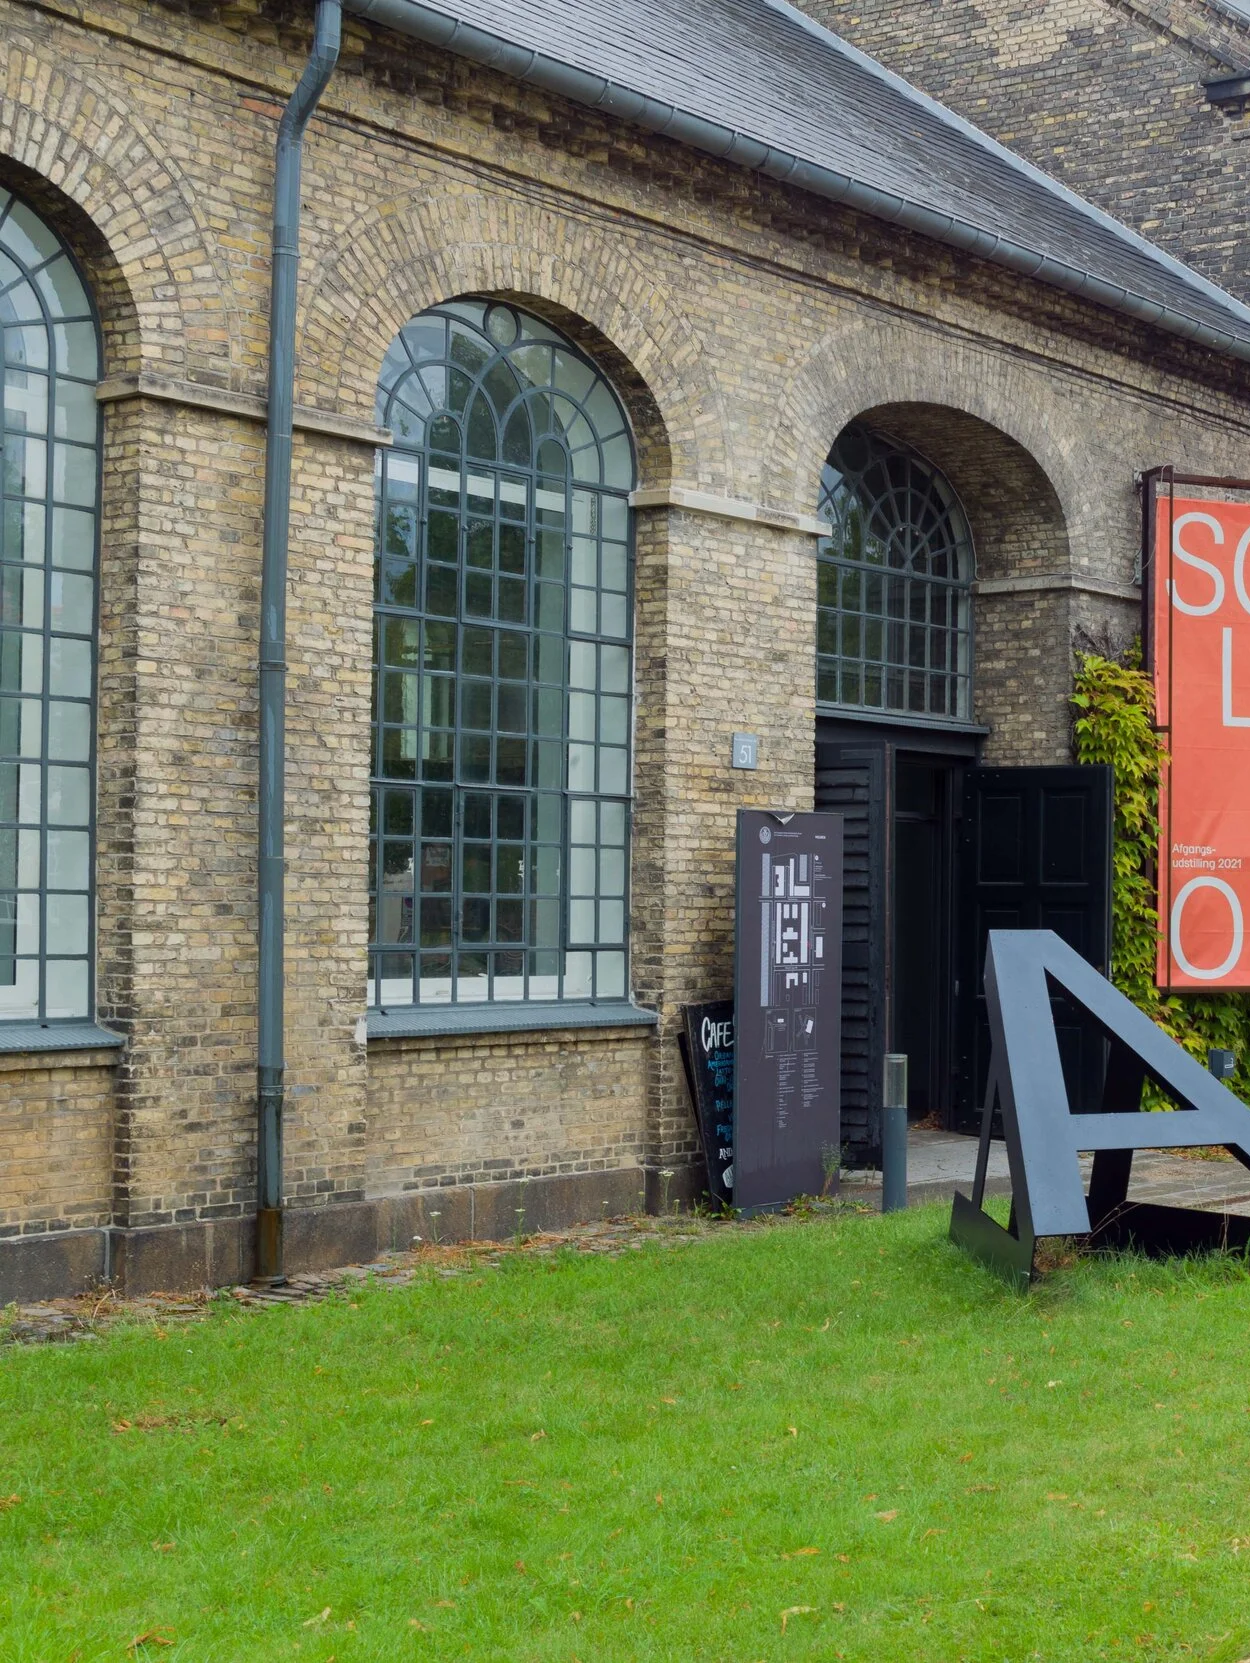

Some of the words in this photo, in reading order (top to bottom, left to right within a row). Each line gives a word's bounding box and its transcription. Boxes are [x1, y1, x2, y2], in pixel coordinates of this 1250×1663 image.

[739, 744, 752, 764] 51
[1172, 843, 1216, 856] Afgangs-
[1172, 858, 1216, 870] udstilling
[1218, 858, 1242, 869] 2021
[701, 1016, 735, 1052] CAFE
